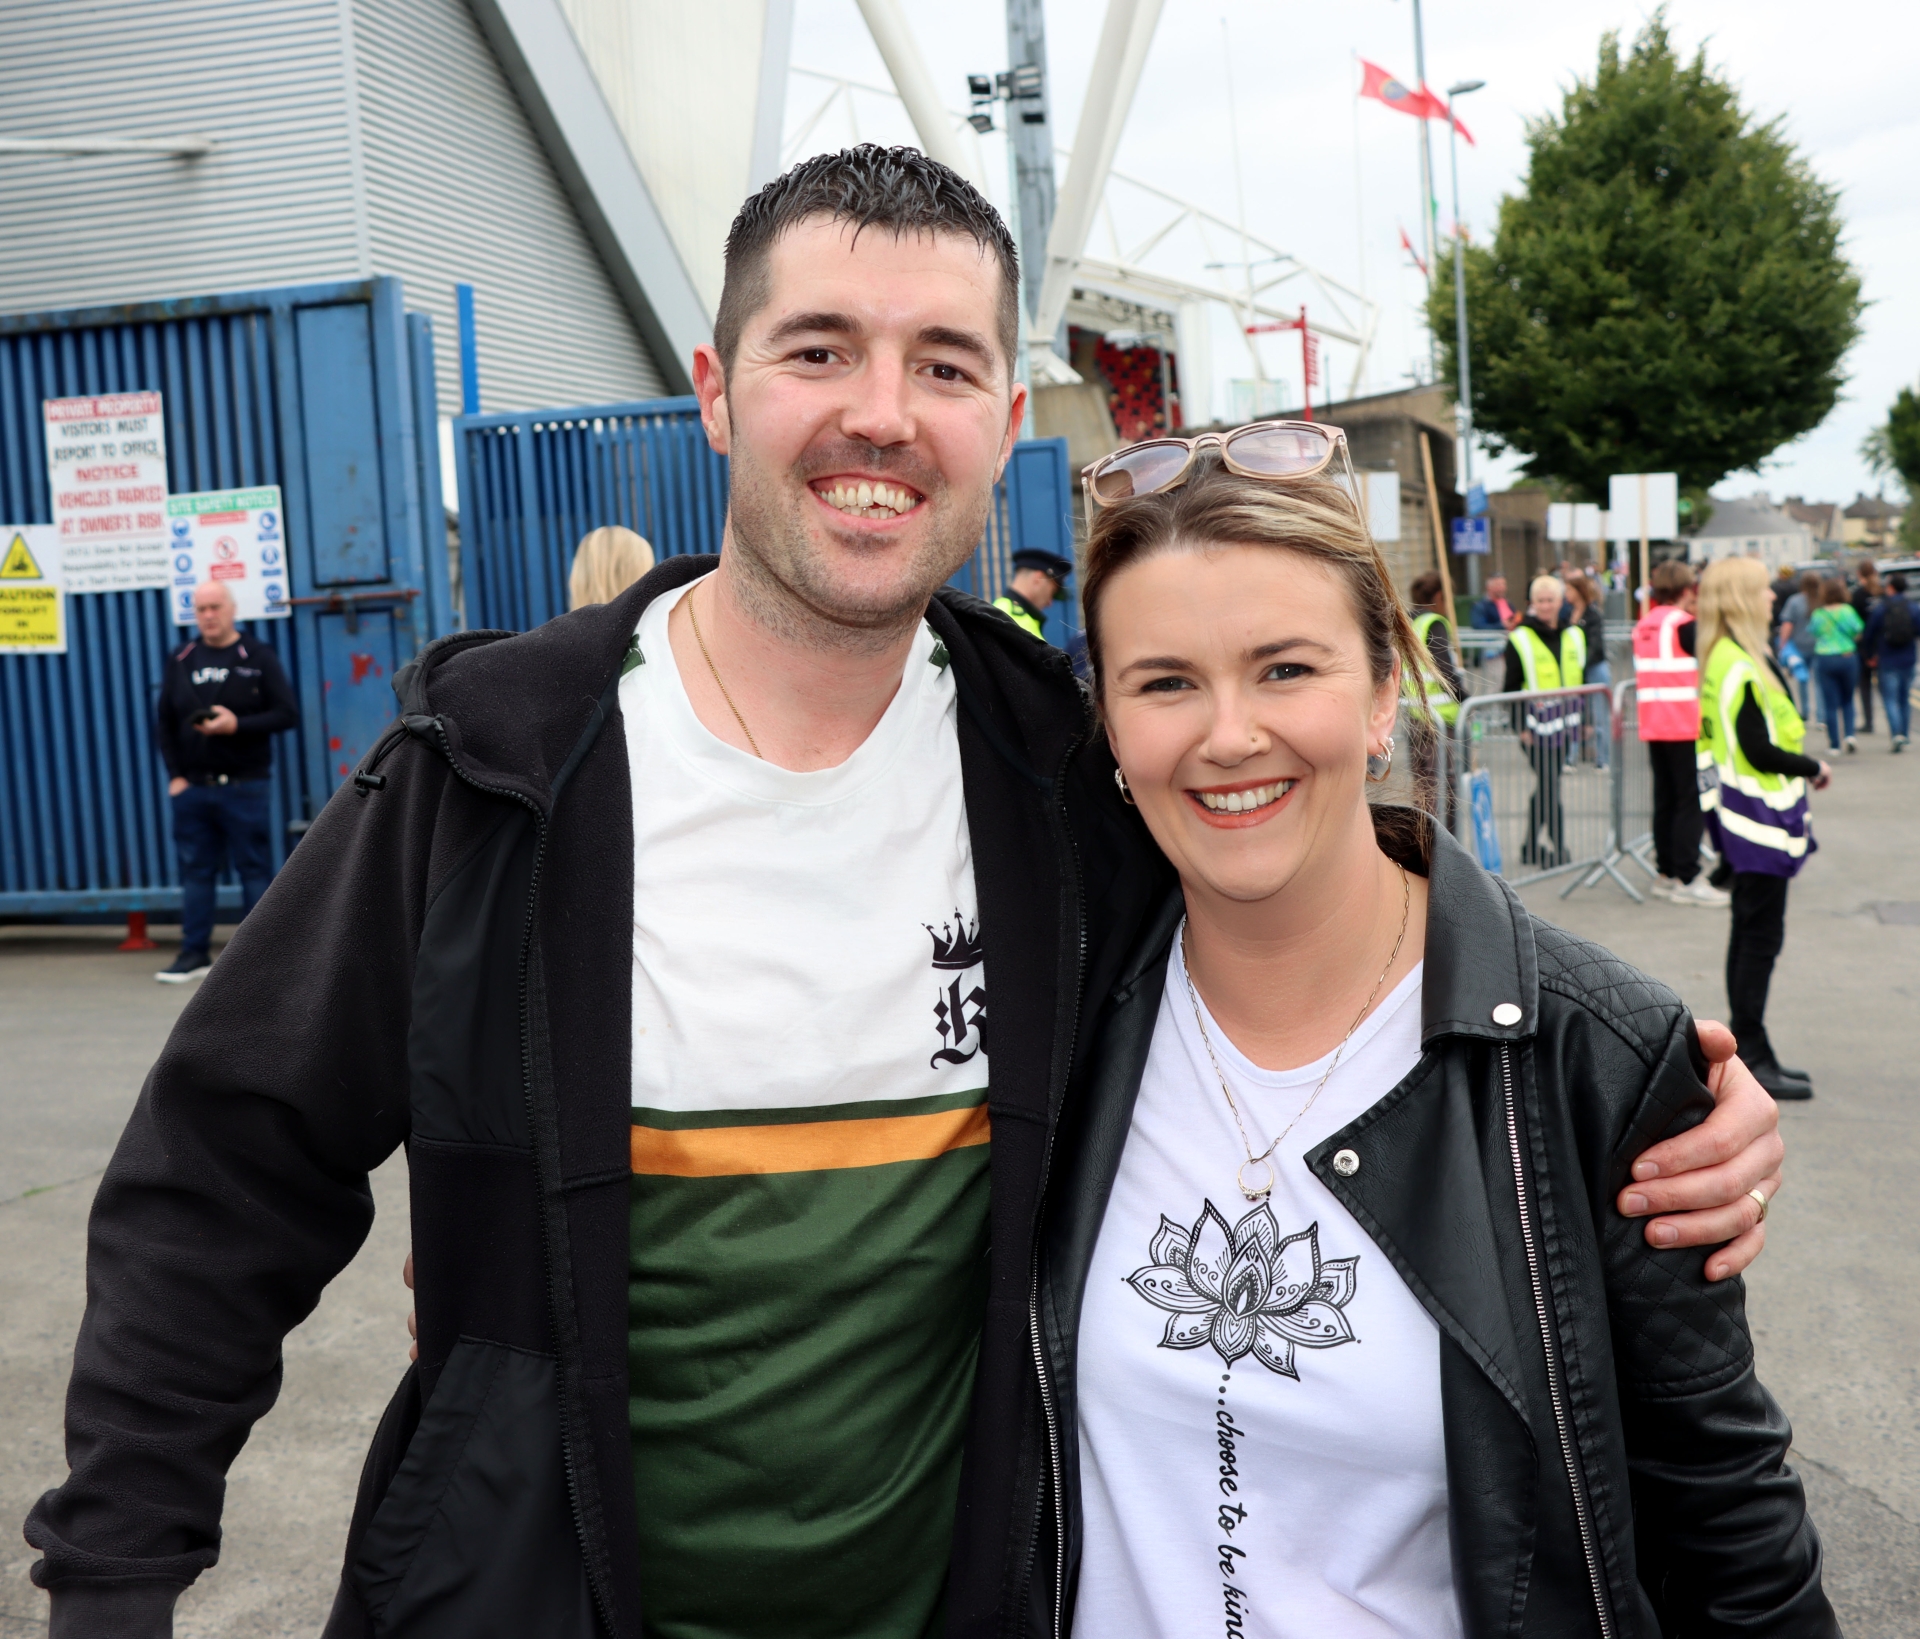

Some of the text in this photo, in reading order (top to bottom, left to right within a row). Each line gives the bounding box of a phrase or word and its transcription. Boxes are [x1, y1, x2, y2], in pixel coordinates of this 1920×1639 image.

[61, 418, 148, 437] VISITORS MUST
[54, 439, 159, 461] REPORT TO OFFICE
[76, 463, 139, 481] NOTICE
[59, 484, 163, 508] VEHICLES PARKED
[60, 517, 74, 534] AT
[137, 511, 164, 529] RISK
[1217, 1502, 1248, 1538] to
[1217, 1544, 1247, 1579] be
